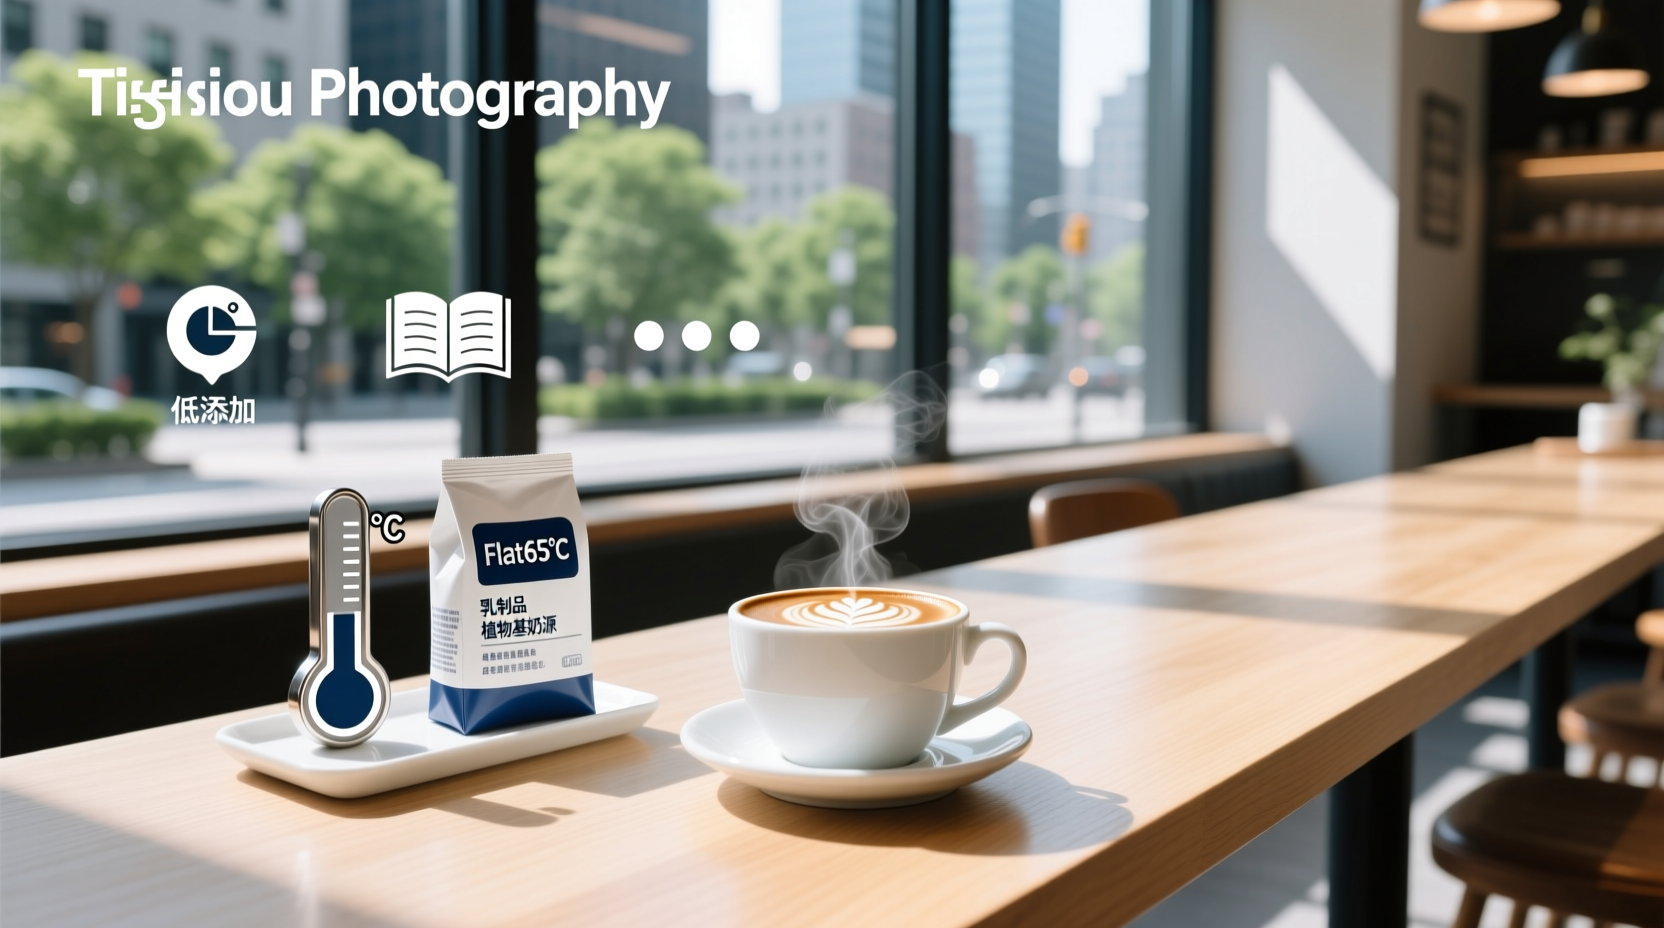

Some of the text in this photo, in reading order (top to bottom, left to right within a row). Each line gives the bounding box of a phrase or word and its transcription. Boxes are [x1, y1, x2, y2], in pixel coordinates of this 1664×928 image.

[484, 537, 570, 566] Flat65°C
[480, 595, 527, 617] 乳制品
